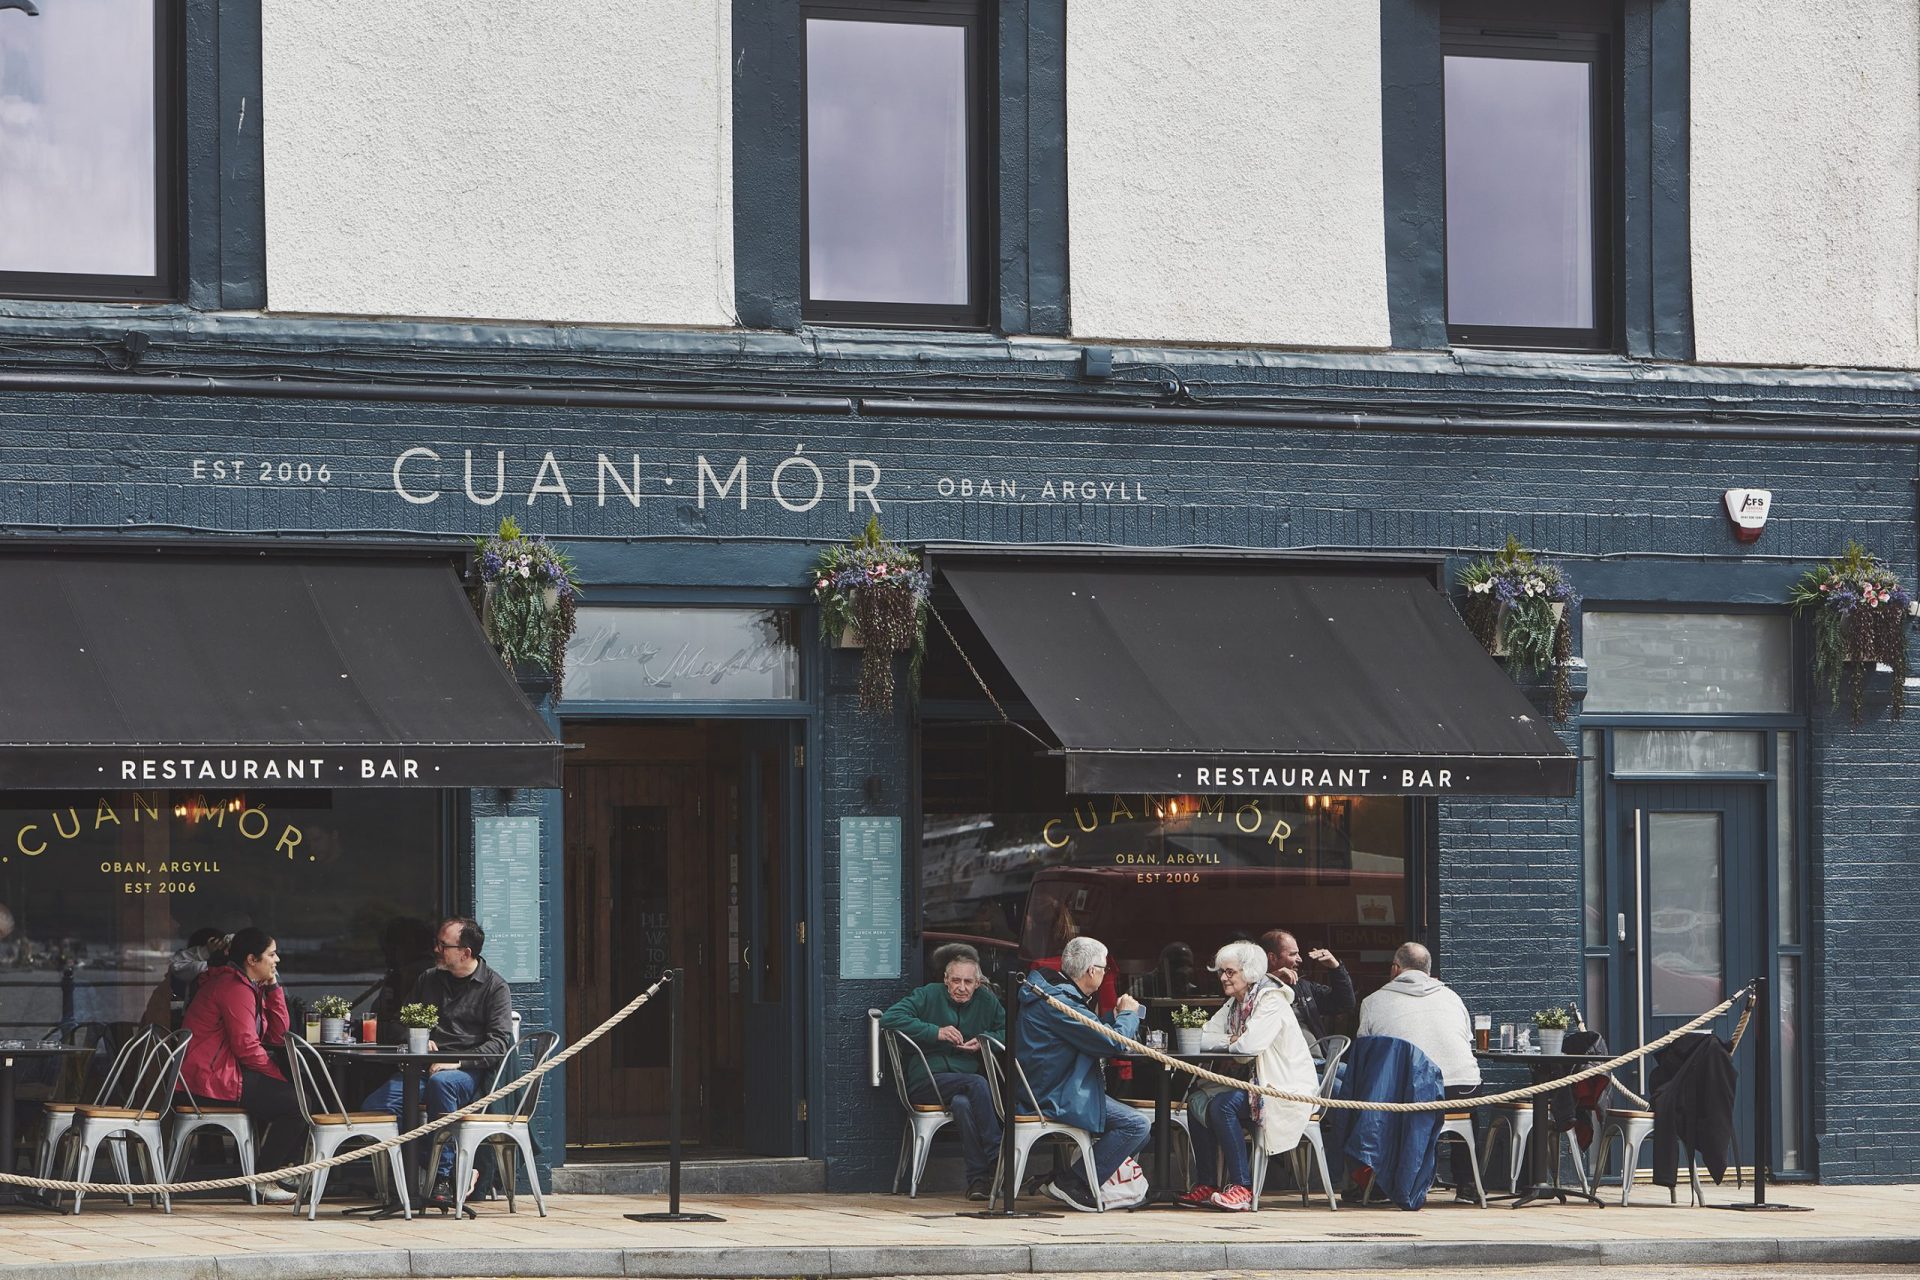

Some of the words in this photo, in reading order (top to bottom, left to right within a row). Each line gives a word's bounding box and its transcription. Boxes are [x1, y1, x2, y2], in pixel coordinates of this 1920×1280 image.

[193, 460, 243, 482] EST
[259, 461, 332, 484] 2006
[391, 446, 641, 508] CUAN
[937, 476, 1027, 504] OBAN,
[1041, 479, 1148, 503] ARGYLL
[121, 759, 324, 780] RESTAURANT
[361, 759, 419, 779] BAR
[1197, 767, 1371, 787] RESTAURANT
[1402, 769, 1452, 788] BAR
[17, 791, 159, 856] CUAN
[1043, 794, 1167, 849] CUAN
[101, 862, 152, 875] OBAN,
[159, 861, 220, 873] ARGYLL
[1115, 854, 1161, 866] OBAN,
[1166, 854, 1221, 864] ARGYLL
[124, 883, 152, 893] EST
[158, 883, 197, 893] 2006
[1136, 874, 1161, 883] EST
[1166, 873, 1200, 883] 2006
